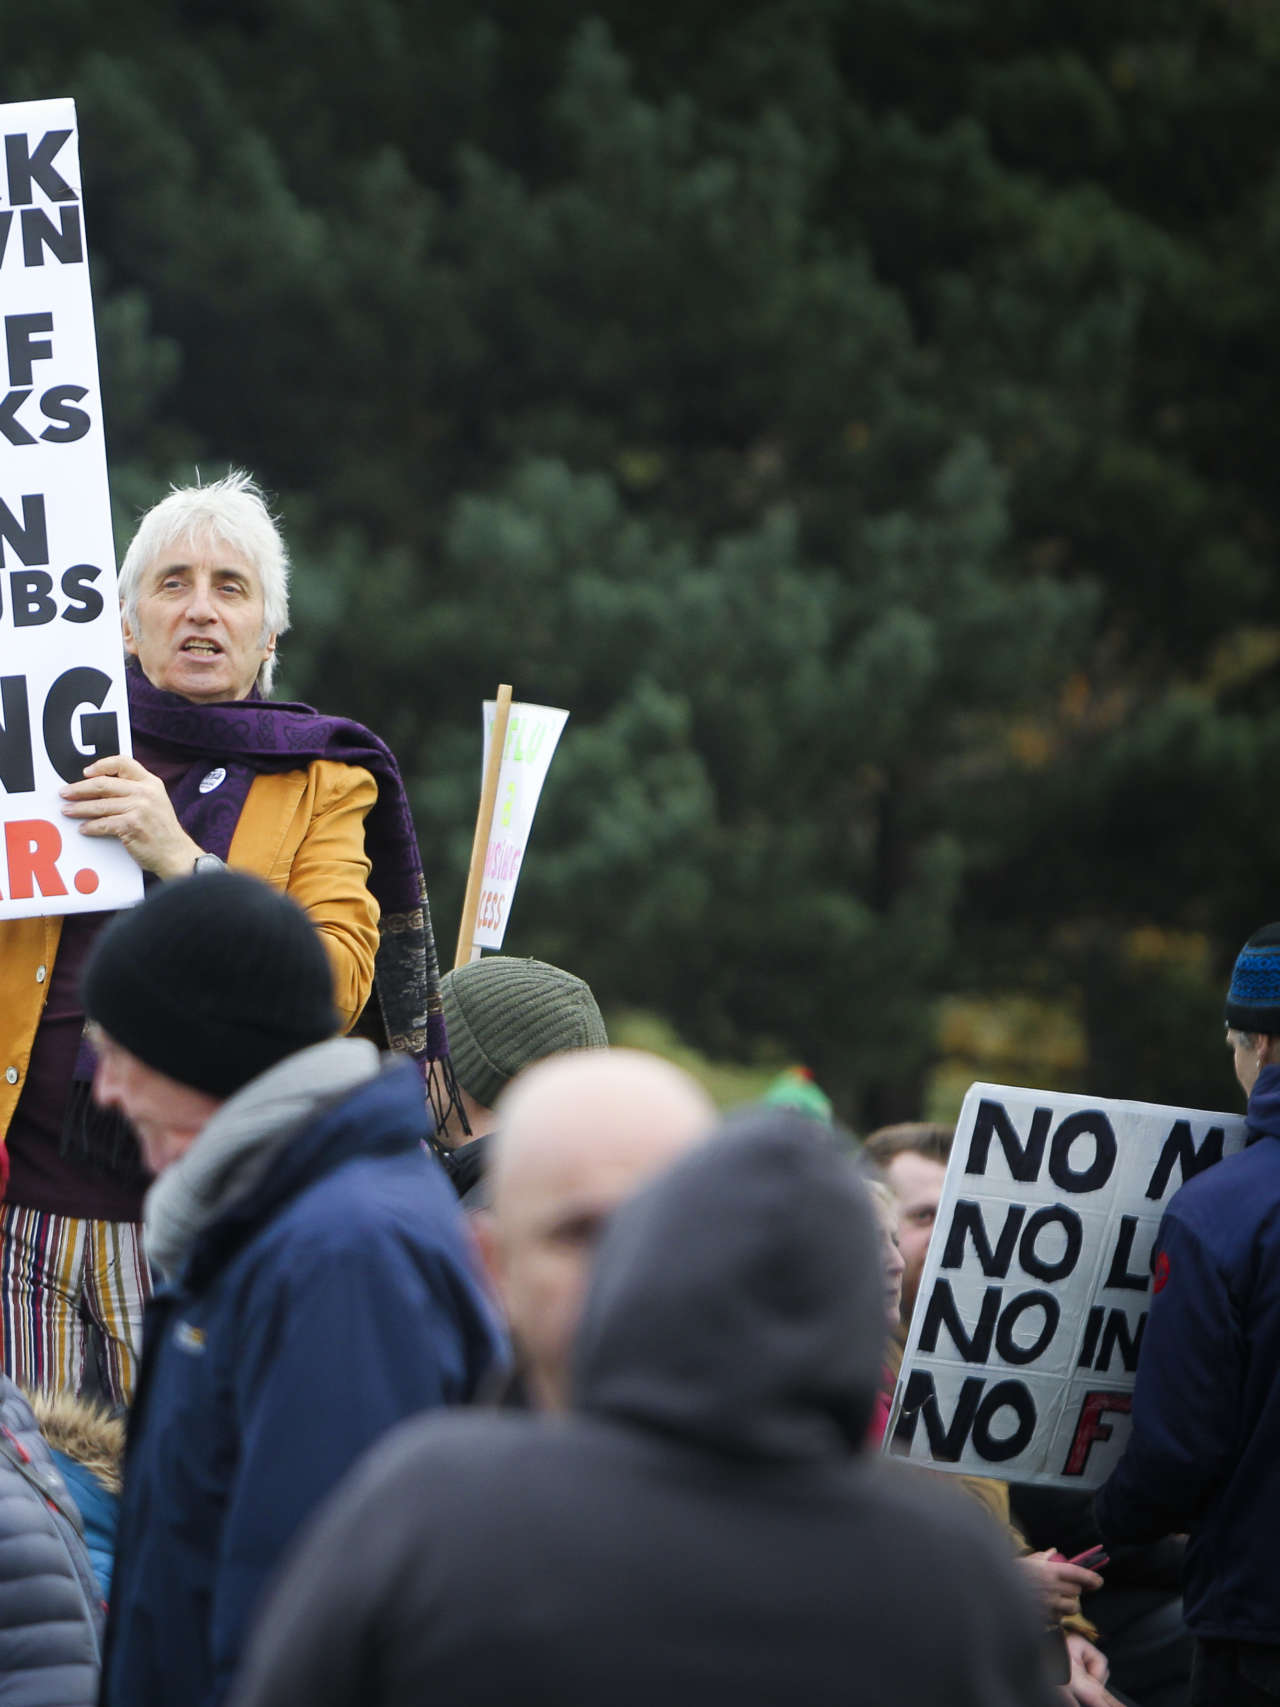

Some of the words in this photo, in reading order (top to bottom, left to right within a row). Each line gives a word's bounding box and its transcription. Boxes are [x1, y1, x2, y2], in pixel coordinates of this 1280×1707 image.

[965, 1098, 1117, 1193] NO
[941, 1199, 1083, 1283] NO
[917, 1277, 1060, 1365] NO
[889, 1369, 1037, 1462] NO
